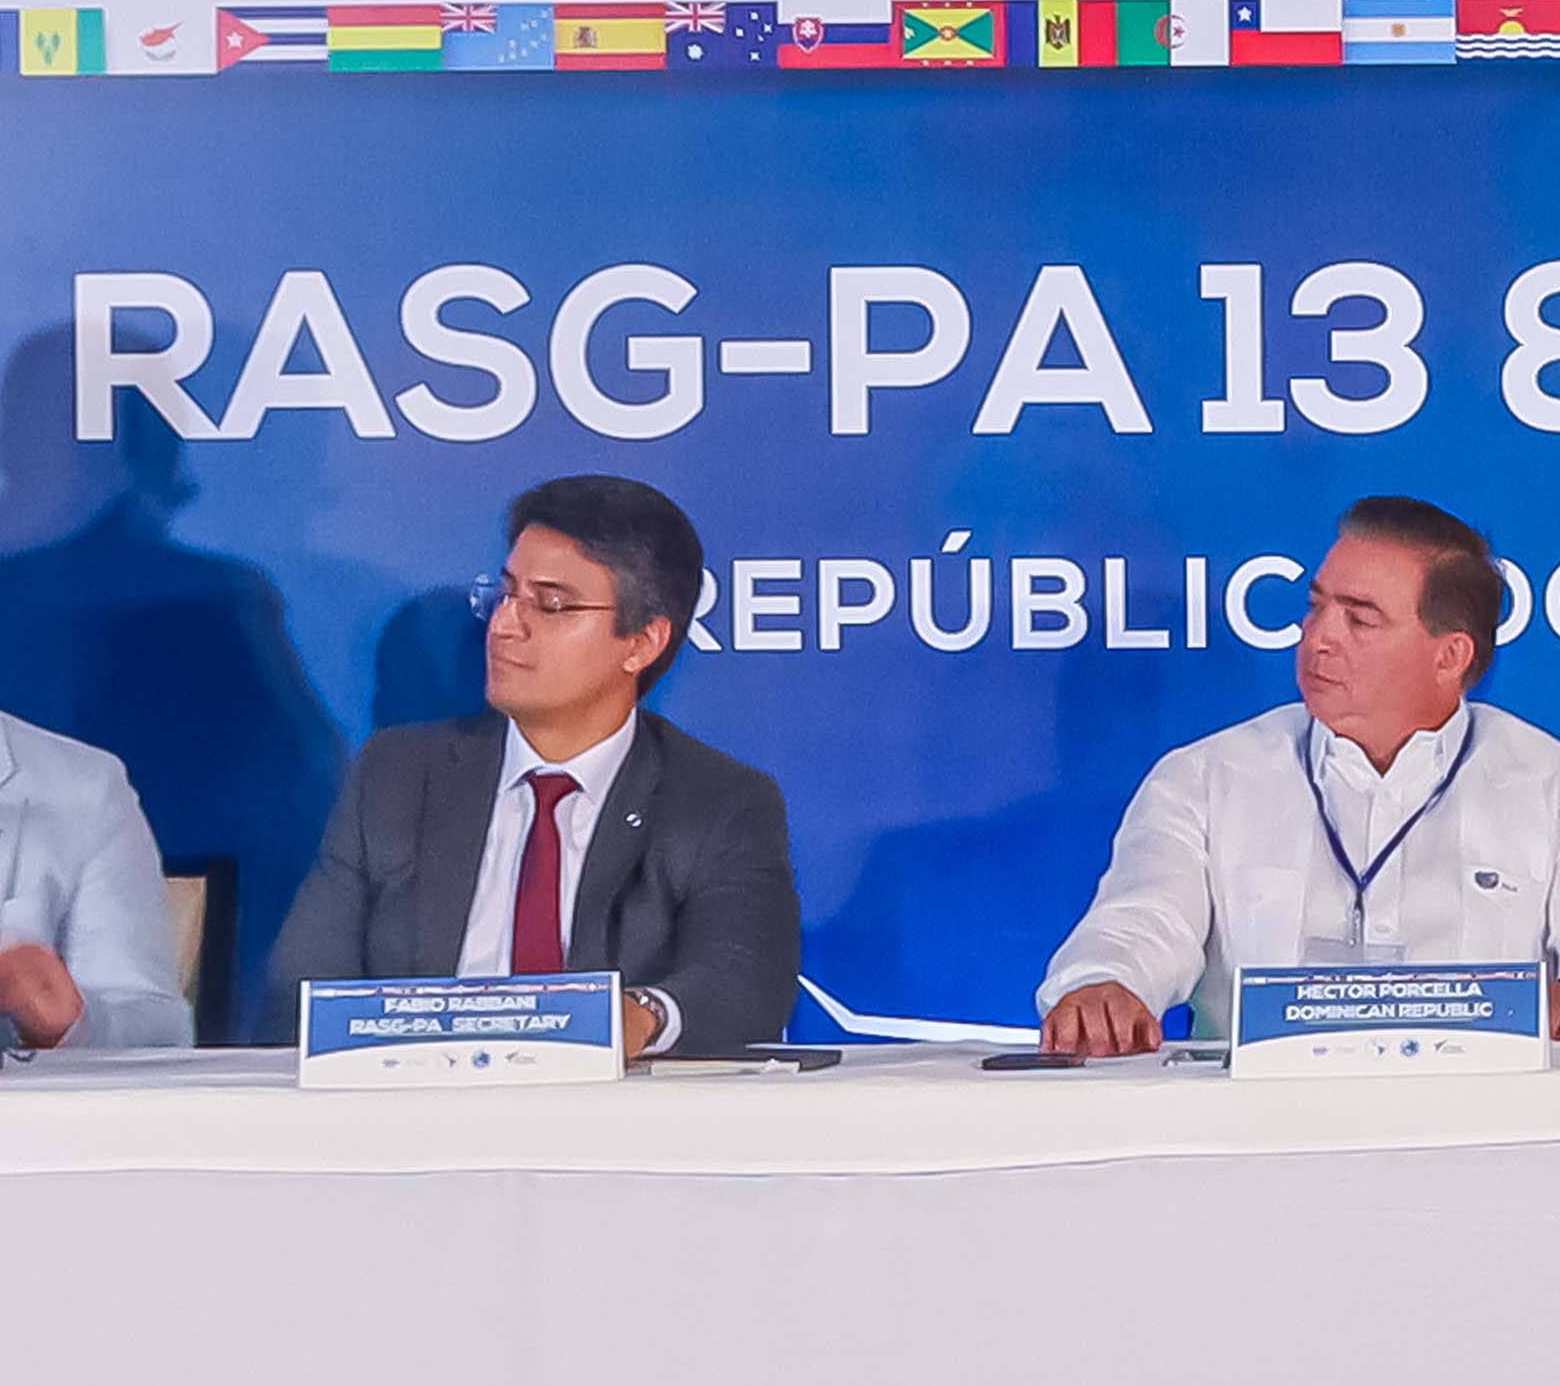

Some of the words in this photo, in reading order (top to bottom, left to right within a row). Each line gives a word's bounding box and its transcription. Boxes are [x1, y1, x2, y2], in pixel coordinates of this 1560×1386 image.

[74, 264, 1153, 441] RASG-PA
[1200, 261, 1430, 435] 13
[687, 530, 1306, 651] EPÚBLIC
[348, 1017, 443, 1035] RASG-PA
[451, 1014, 571, 1032] SECRETARY
[1285, 1004, 1395, 1021] DOMINICAN
[1397, 1001, 1493, 1019] REPUBLIC
